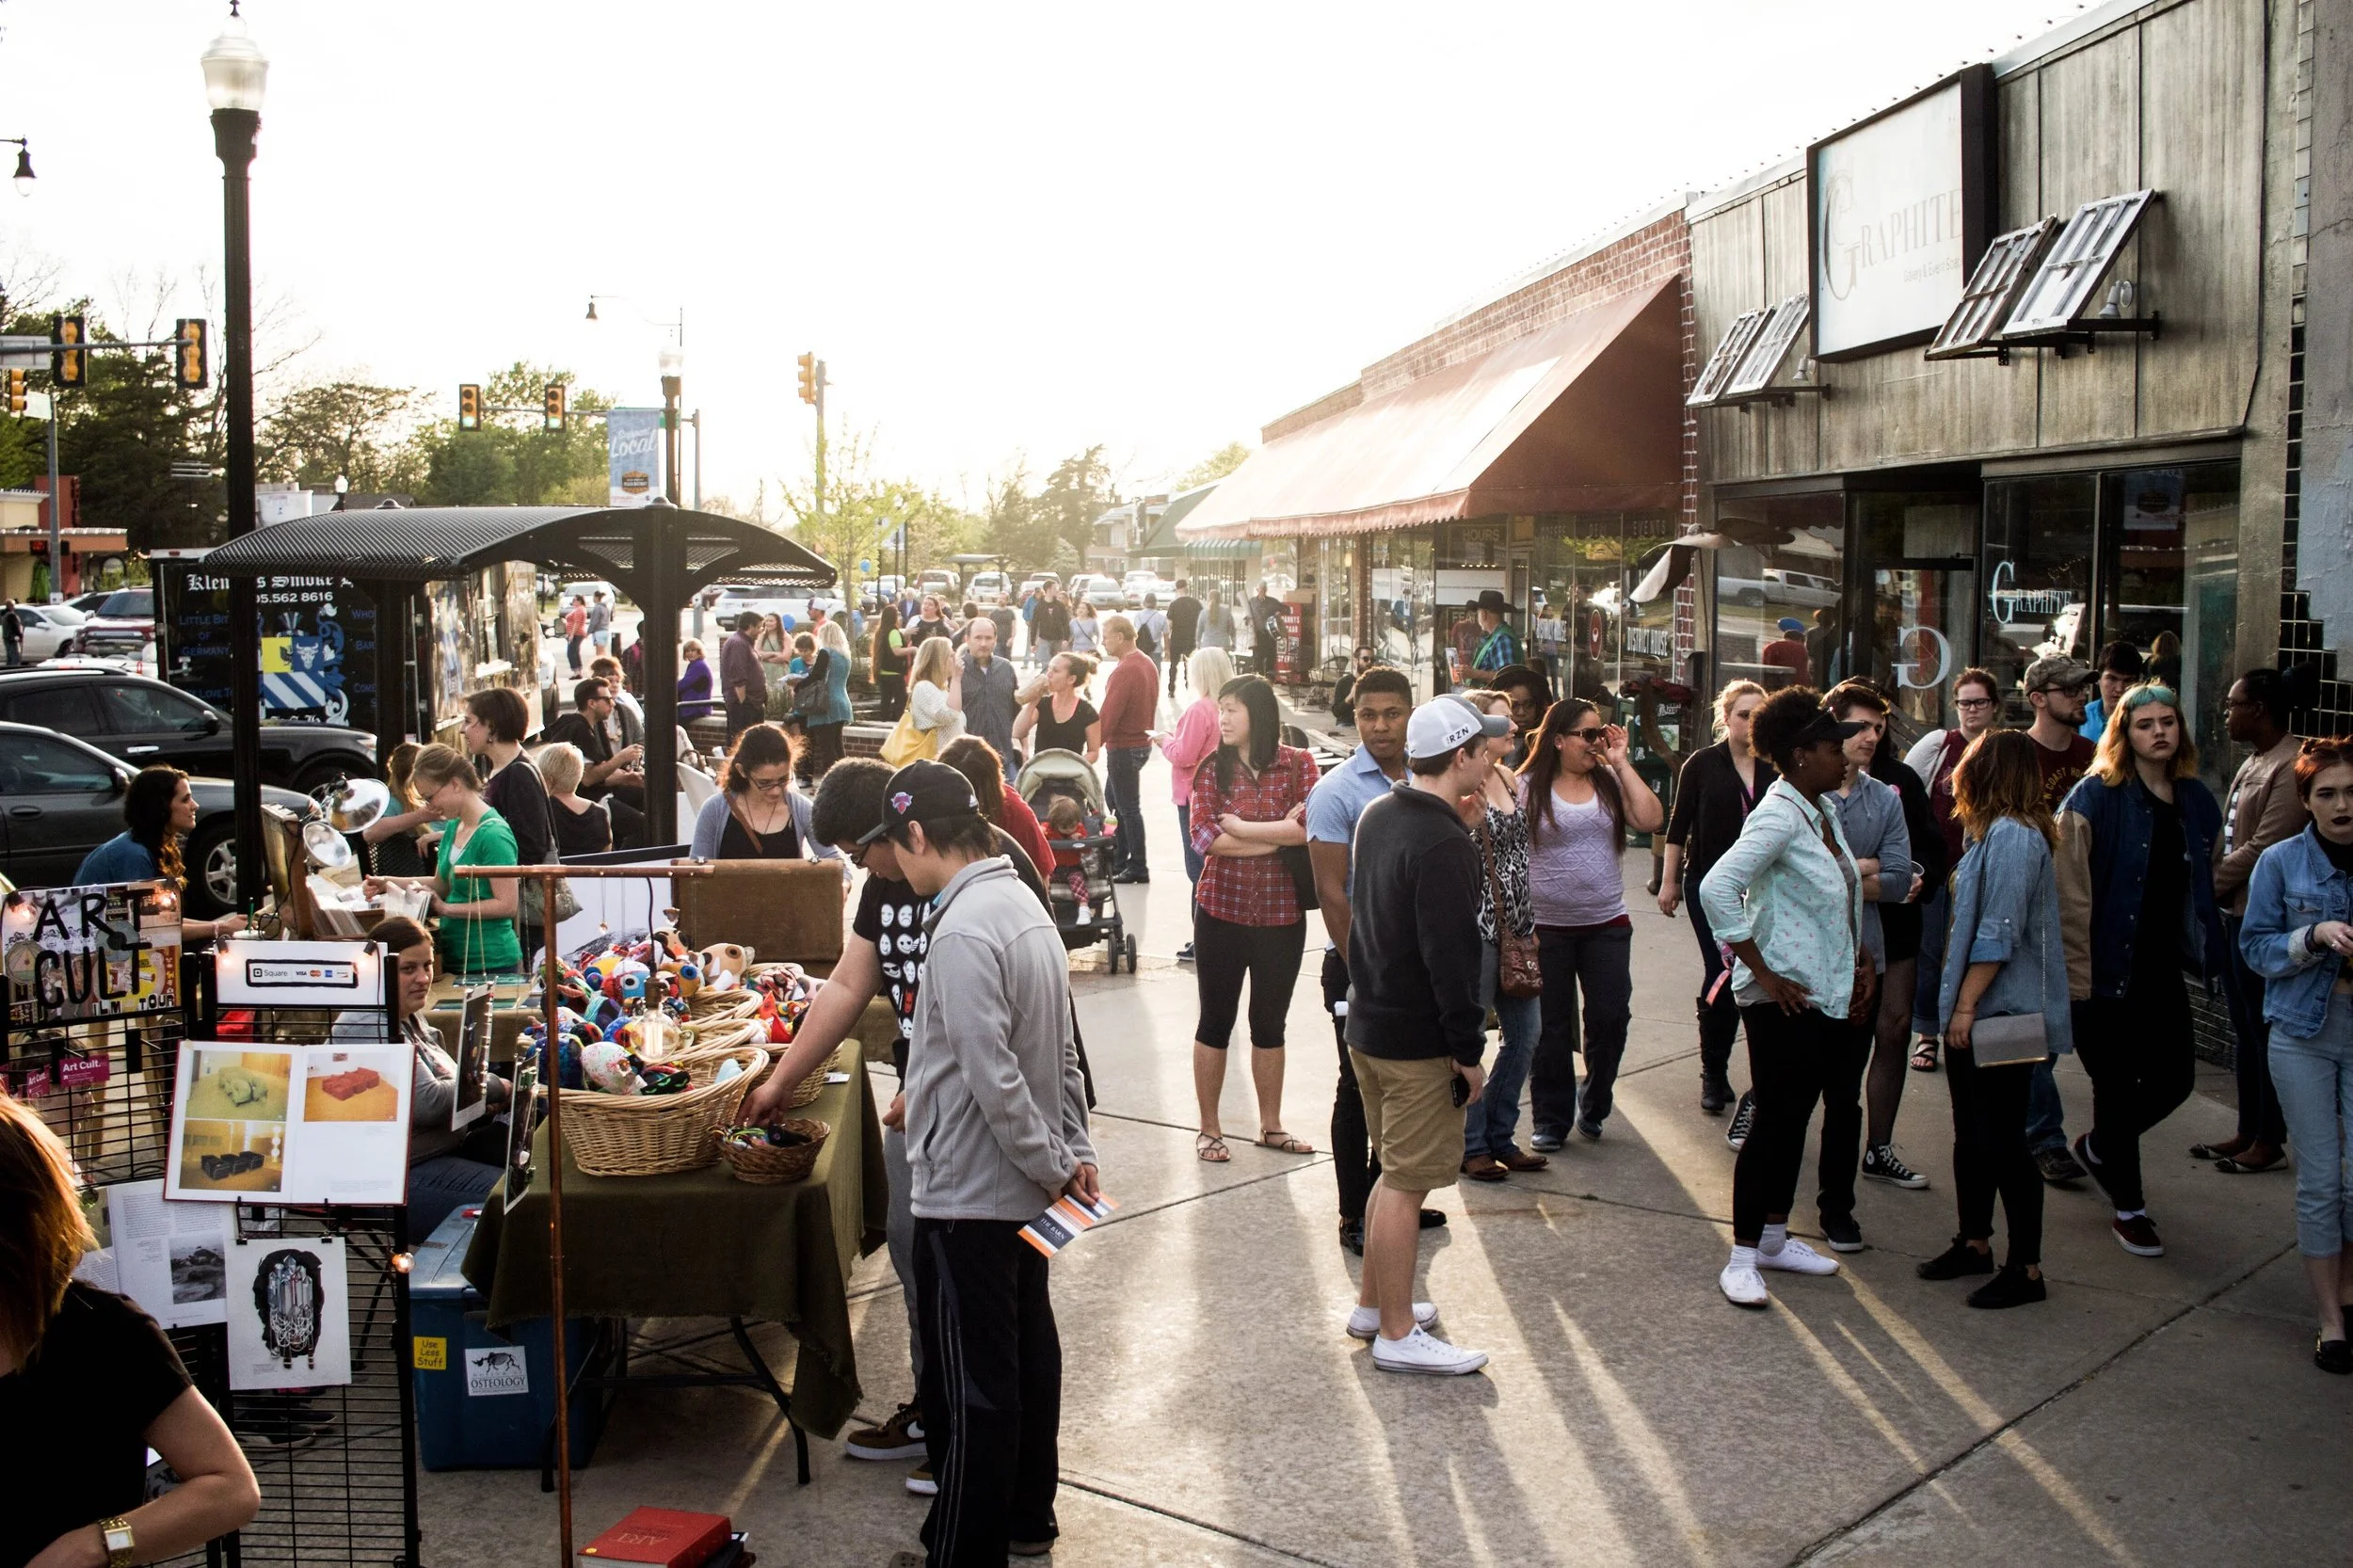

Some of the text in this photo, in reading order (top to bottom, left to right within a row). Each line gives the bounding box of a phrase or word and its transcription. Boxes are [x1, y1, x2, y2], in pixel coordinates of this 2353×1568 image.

[1824, 170, 1962, 301] GRAPHITE
[611, 428, 657, 458] Local
[1462, 528, 1500, 541] HOURS
[256, 591, 333, 603] 5.562 8616
[179, 614, 212, 626] LITTLE
[182, 646, 231, 657] GERMANY
[33, 888, 158, 941] ART
[35, 941, 152, 1009] CULT
[138, 994, 174, 1011] TOUR
[62, 1064, 77, 1072] Art
[422, 1339, 438, 1349] Use
[420, 1348, 440, 1356] Less
[417, 1356, 443, 1368] Stuff
[471, 1376, 525, 1388] OSTEOLOGY
